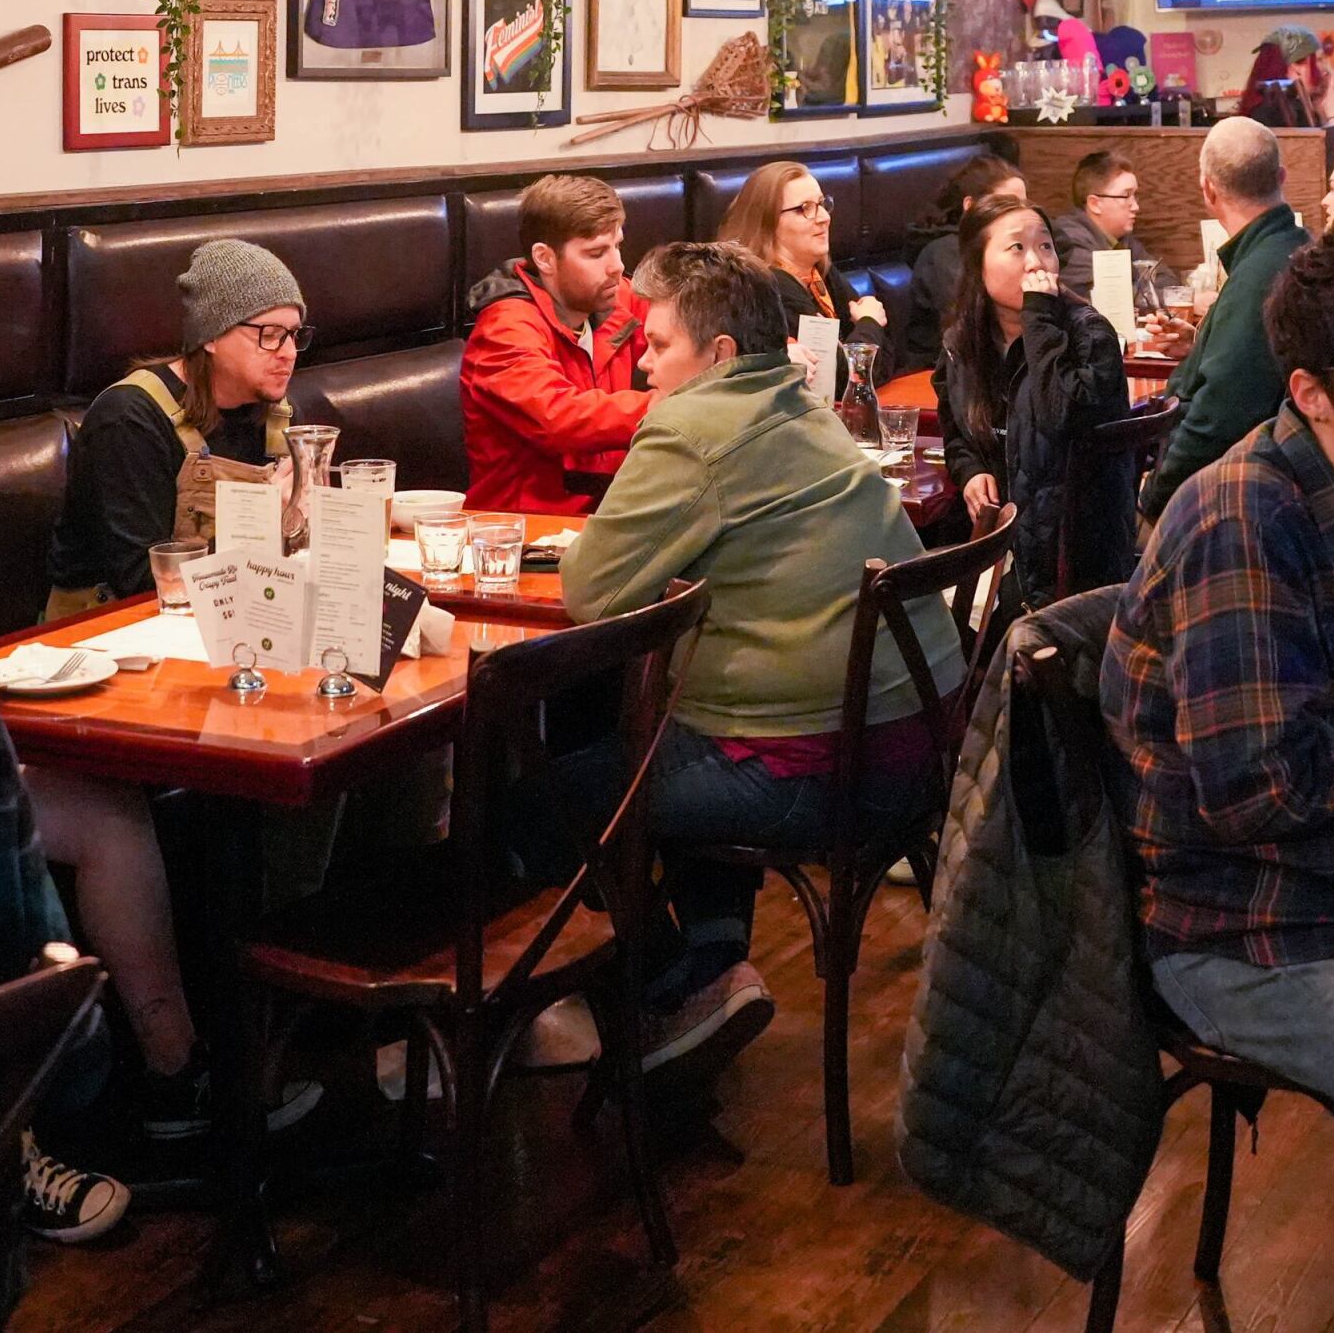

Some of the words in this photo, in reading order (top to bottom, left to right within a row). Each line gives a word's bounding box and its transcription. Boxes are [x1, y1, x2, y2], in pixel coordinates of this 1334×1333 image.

[86, 46, 135, 67] protect
[112, 74, 148, 90] trans
[95, 97, 127, 115] lives
[246, 559, 273, 578] happy
[273, 567, 296, 581] hour
[384, 580, 413, 601] night
[213, 596, 235, 608] ONLY
